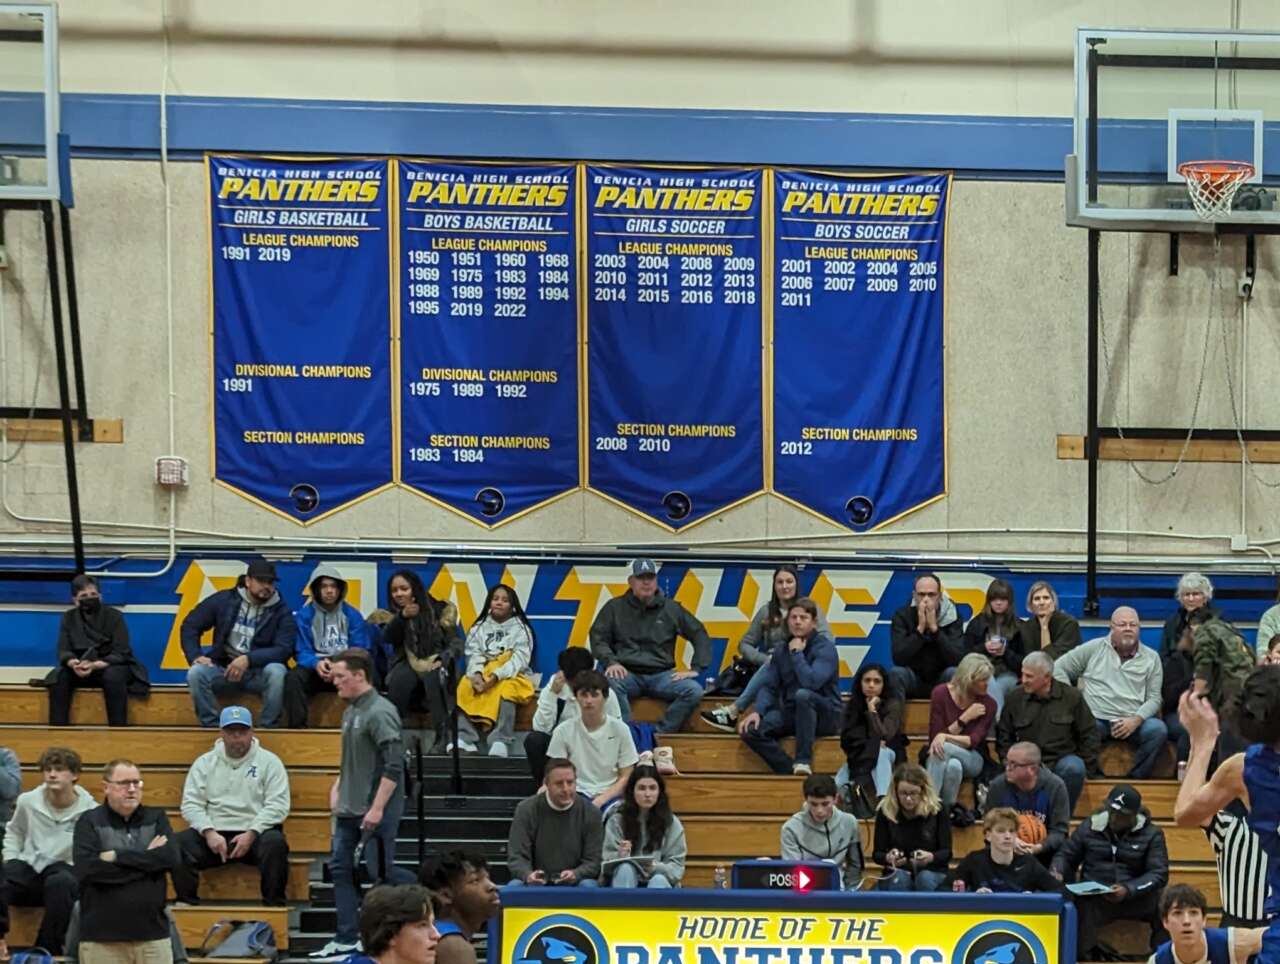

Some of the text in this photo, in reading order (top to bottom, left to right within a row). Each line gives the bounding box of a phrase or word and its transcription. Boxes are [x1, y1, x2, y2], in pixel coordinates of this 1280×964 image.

[218, 167, 381, 179] BENICIA HIGH SCHOOL
[594, 176, 755, 187] BENICIA HIGH SCHOOL
[218, 179, 380, 202] PANTHERS
[407, 183, 568, 206] PANTHERS
[594, 188, 755, 211] PANTHERS
[782, 193, 940, 216] PANTHERS
[234, 210, 368, 226] GIRLS BASKETBALL
[424, 214, 553, 231] BOYS BASKETBALL
[626, 218, 725, 234] GIRLS SOCCER
[815, 224, 909, 239] BOYS SOCCER
[243, 233, 359, 247] LEAGUE CHAMPIONS
[432, 238, 547, 252] LEAGUE CHAMPIONS
[222, 246, 291, 261] 1991 2019
[619, 242, 733, 256] LEAGUE CHAMPIONS
[805, 246, 918, 261] LEAGUE CHAMPIONS
[408, 250, 569, 267] 1950 1951 1960 1968
[595, 254, 755, 271] 2003 2004 2008 2009
[782, 259, 937, 276] 2001 2002 2004 2005
[595, 288, 755, 304] 2014 2015 2016 2018
[781, 292, 810, 306] 2011
[409, 301, 526, 317] 1995 2019 2022
[236, 364, 371, 378] DIVISIONAL CHAMPIONS
[422, 368, 557, 382] DIVISIONAL CHAMPIONS
[223, 378, 252, 392] 1991
[410, 382, 526, 397] 1975 1989 1992
[244, 431, 365, 444] SECTION CHAMPIONS
[617, 423, 736, 437] SECTION CHAMPIONS
[430, 435, 550, 449] SECTION CHAMPIONS
[596, 437, 670, 451] 2008 2010
[781, 442, 812, 455] 2012
[409, 448, 484, 462] 1983 1984
[677, 916, 886, 941] HOME OF THE
